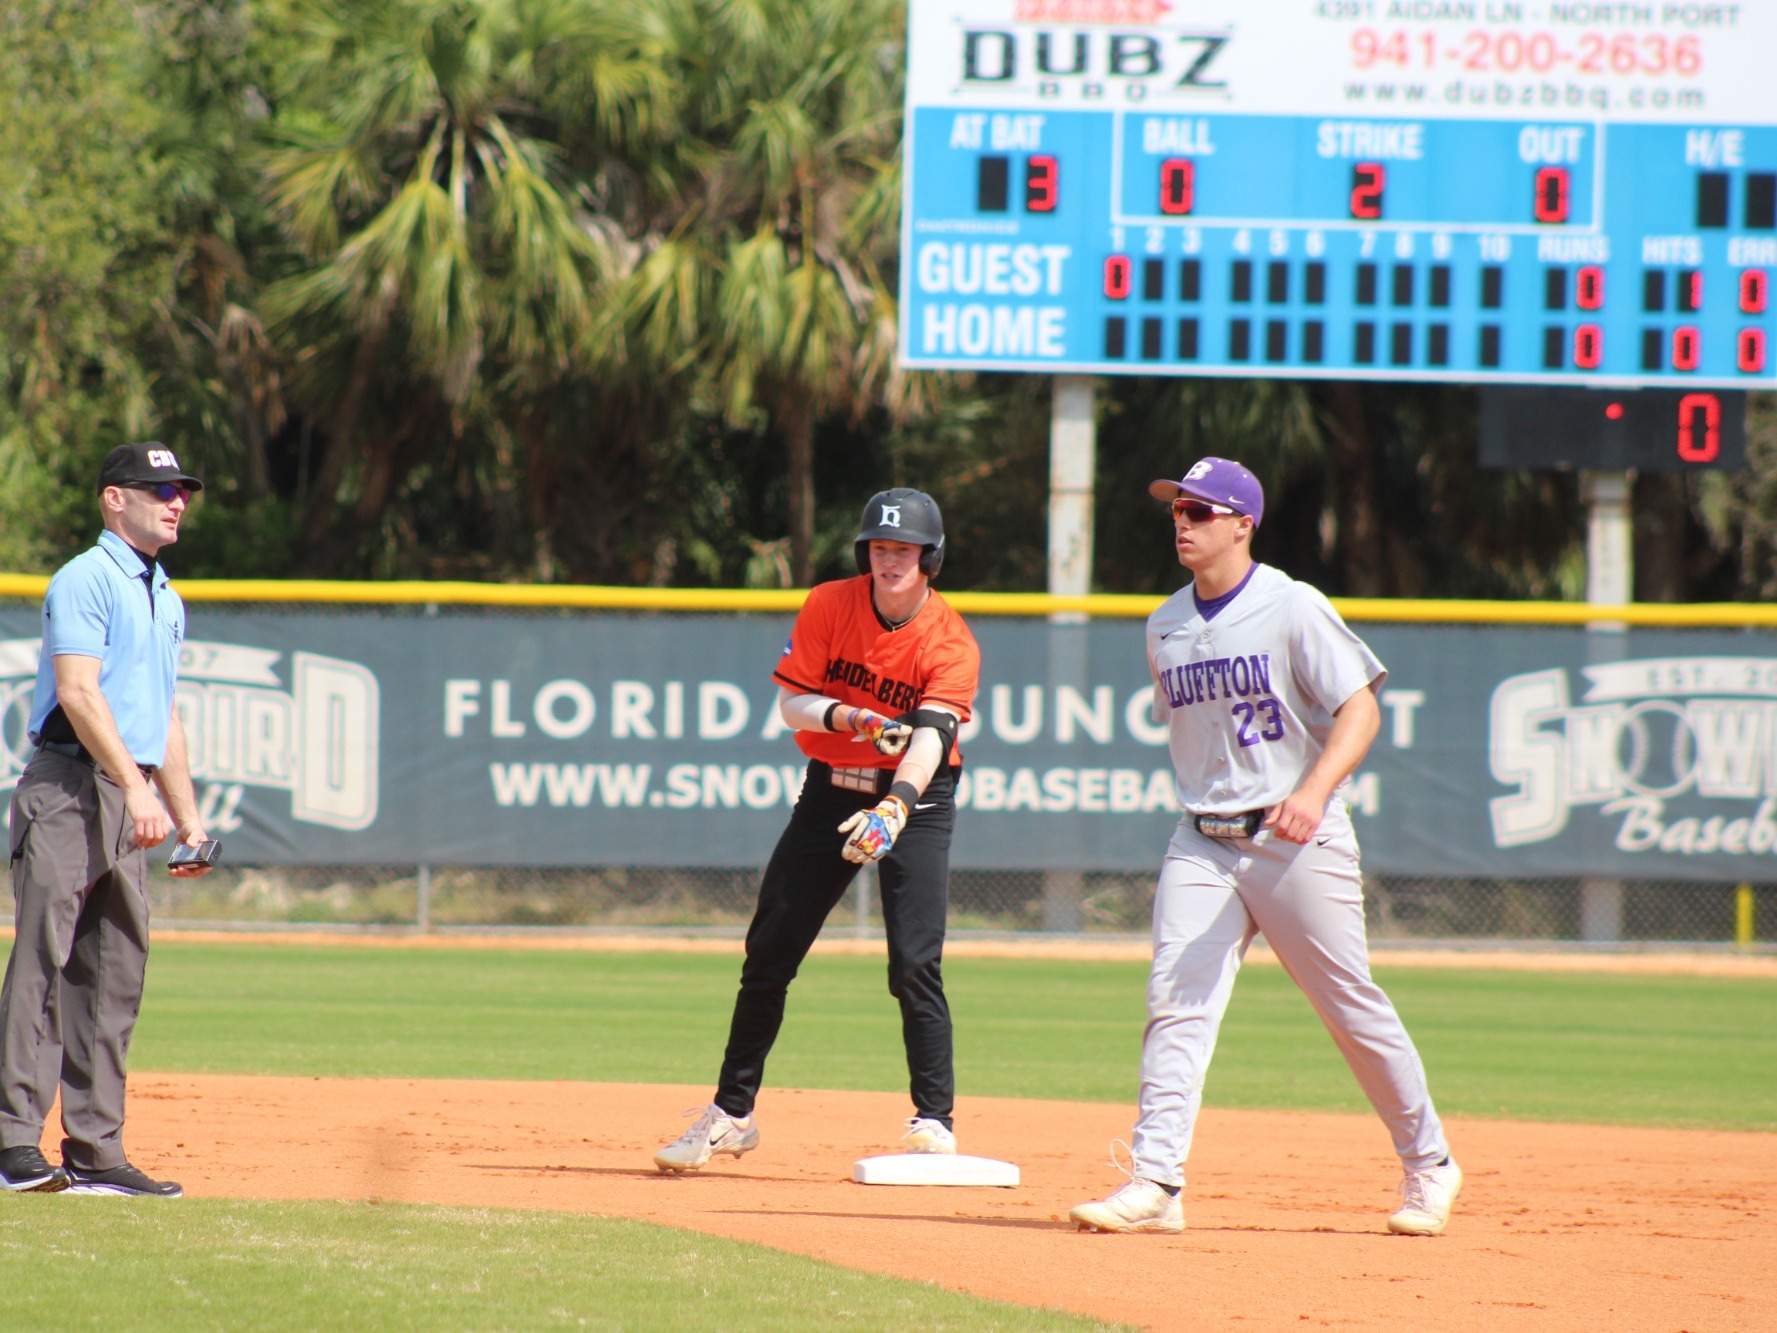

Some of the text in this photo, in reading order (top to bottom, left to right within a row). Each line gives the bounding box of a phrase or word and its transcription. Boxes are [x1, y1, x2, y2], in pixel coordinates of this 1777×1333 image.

[1387, 0, 1475, 21] AIDAN
[1486, 1, 1523, 23] LN
[1551, 3, 1652, 26] NORTH
[1663, 4, 1741, 28] PORT
[962, 29, 1231, 88] DUBZ
[1350, 27, 1703, 77] 941-200-2636
[1345, 80, 1706, 112] www.dubzbbq.com
[950, 114, 1045, 150] AT BAT
[1143, 118, 1215, 155] BALL
[1317, 120, 1424, 161] STRIKE
[1518, 126, 1585, 164] OUT
[1684, 129, 1744, 169] H/E
[1025, 156, 1059, 213] 3
[1159, 159, 1194, 215] 0
[1350, 163, 1386, 219] 2
[1535, 167, 1569, 223] 0
[918, 241, 1071, 296] GUEST
[1110, 228, 1125, 252] 1
[1145, 227, 1164, 254] 2
[1181, 228, 1202, 254] 3
[1232, 228, 1251, 254] 4
[1269, 229, 1289, 256] 5
[1306, 230, 1326, 257] 6
[1358, 232, 1377, 257] 7
[1395, 233, 1415, 259] 8
[1431, 234, 1451, 260] 9
[1478, 235, 1511, 261] 10
[1537, 236, 1609, 263] RUNS
[1642, 236, 1702, 266] HITS
[1104, 254, 1131, 299] 0
[1575, 265, 1604, 310] 0
[1739, 268, 1768, 314] 0
[922, 305, 1066, 357] HOME
[1574, 323, 1602, 369] 0
[1672, 325, 1699, 371] 0
[1737, 327, 1766, 373] 0
[1677, 393, 1721, 463] 0
[1231, 698, 1285, 748] 23
[1488, 667, 1777, 848] SNOW
[1601, 794, 1777, 855] Baseb
